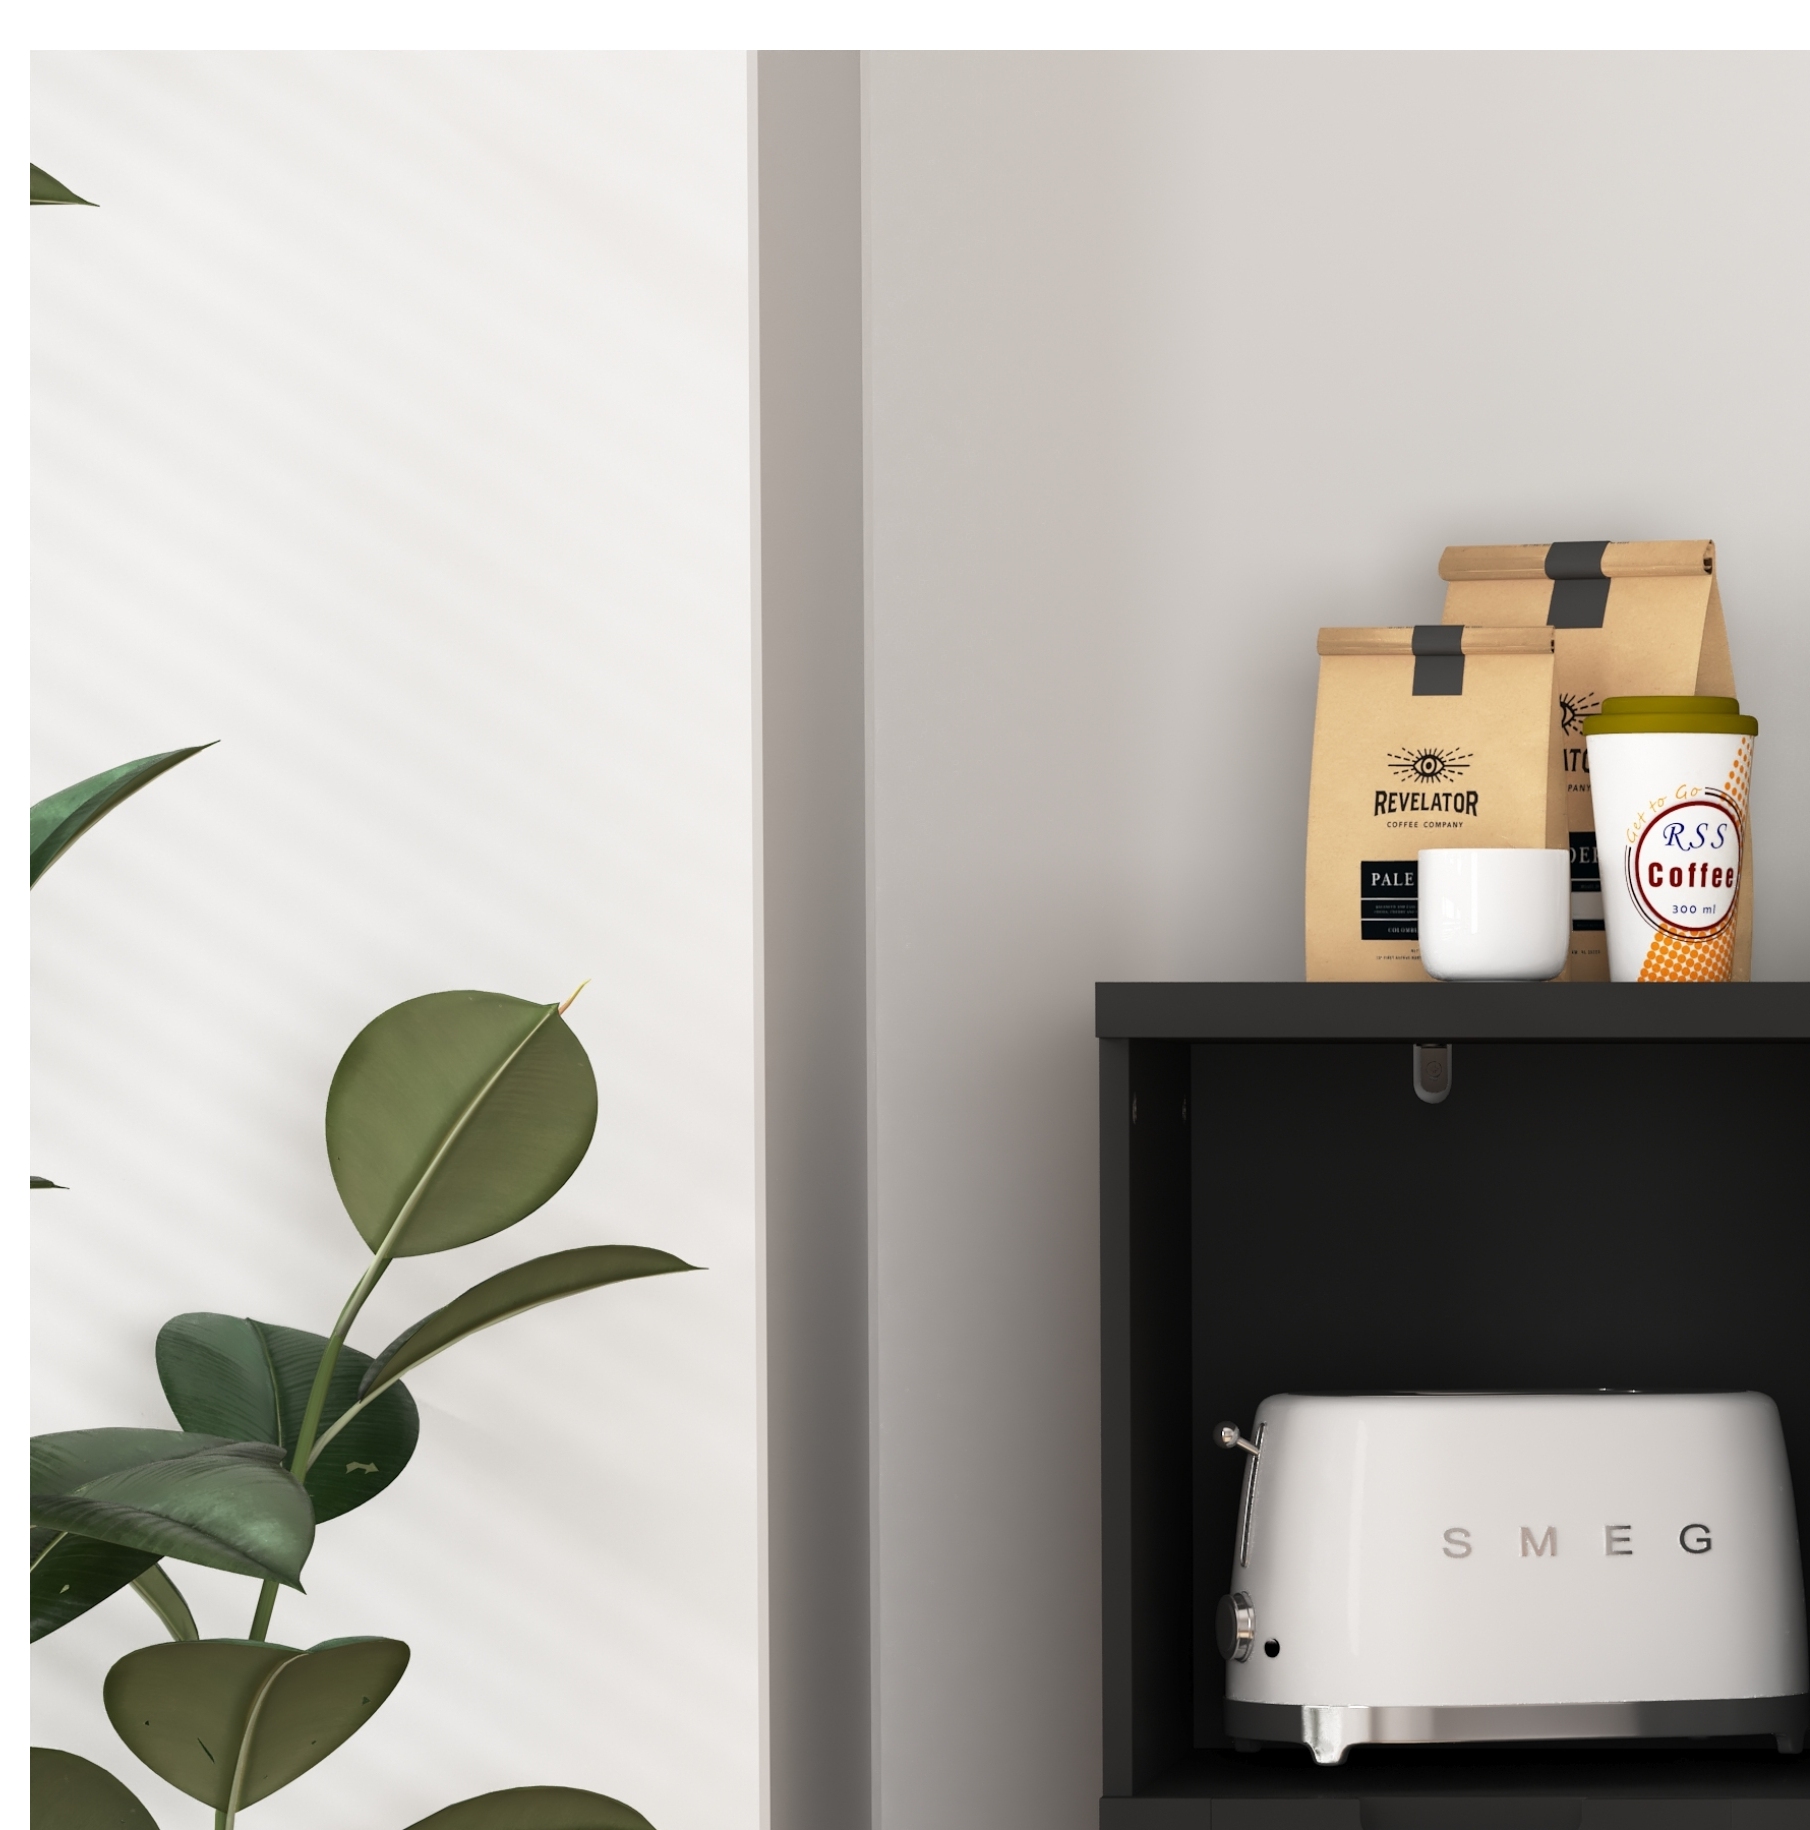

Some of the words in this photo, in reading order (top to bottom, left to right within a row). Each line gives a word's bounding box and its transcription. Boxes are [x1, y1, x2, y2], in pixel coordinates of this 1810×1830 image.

[1567, 784, 1591, 792] PANY
[1374, 790, 1479, 817] REVELATOR
[1626, 811, 1647, 843] Get
[1649, 796, 1667, 812] to
[1675, 784, 1703, 800] Go
[1662, 822, 1728, 851] RSS
[1371, 872, 1415, 886] PALE
[1648, 862, 1734, 888] Coffee
[1672, 904, 1697, 914] 300
[1702, 904, 1717, 914] ml
[1442, 1523, 1714, 1559] SMEG
